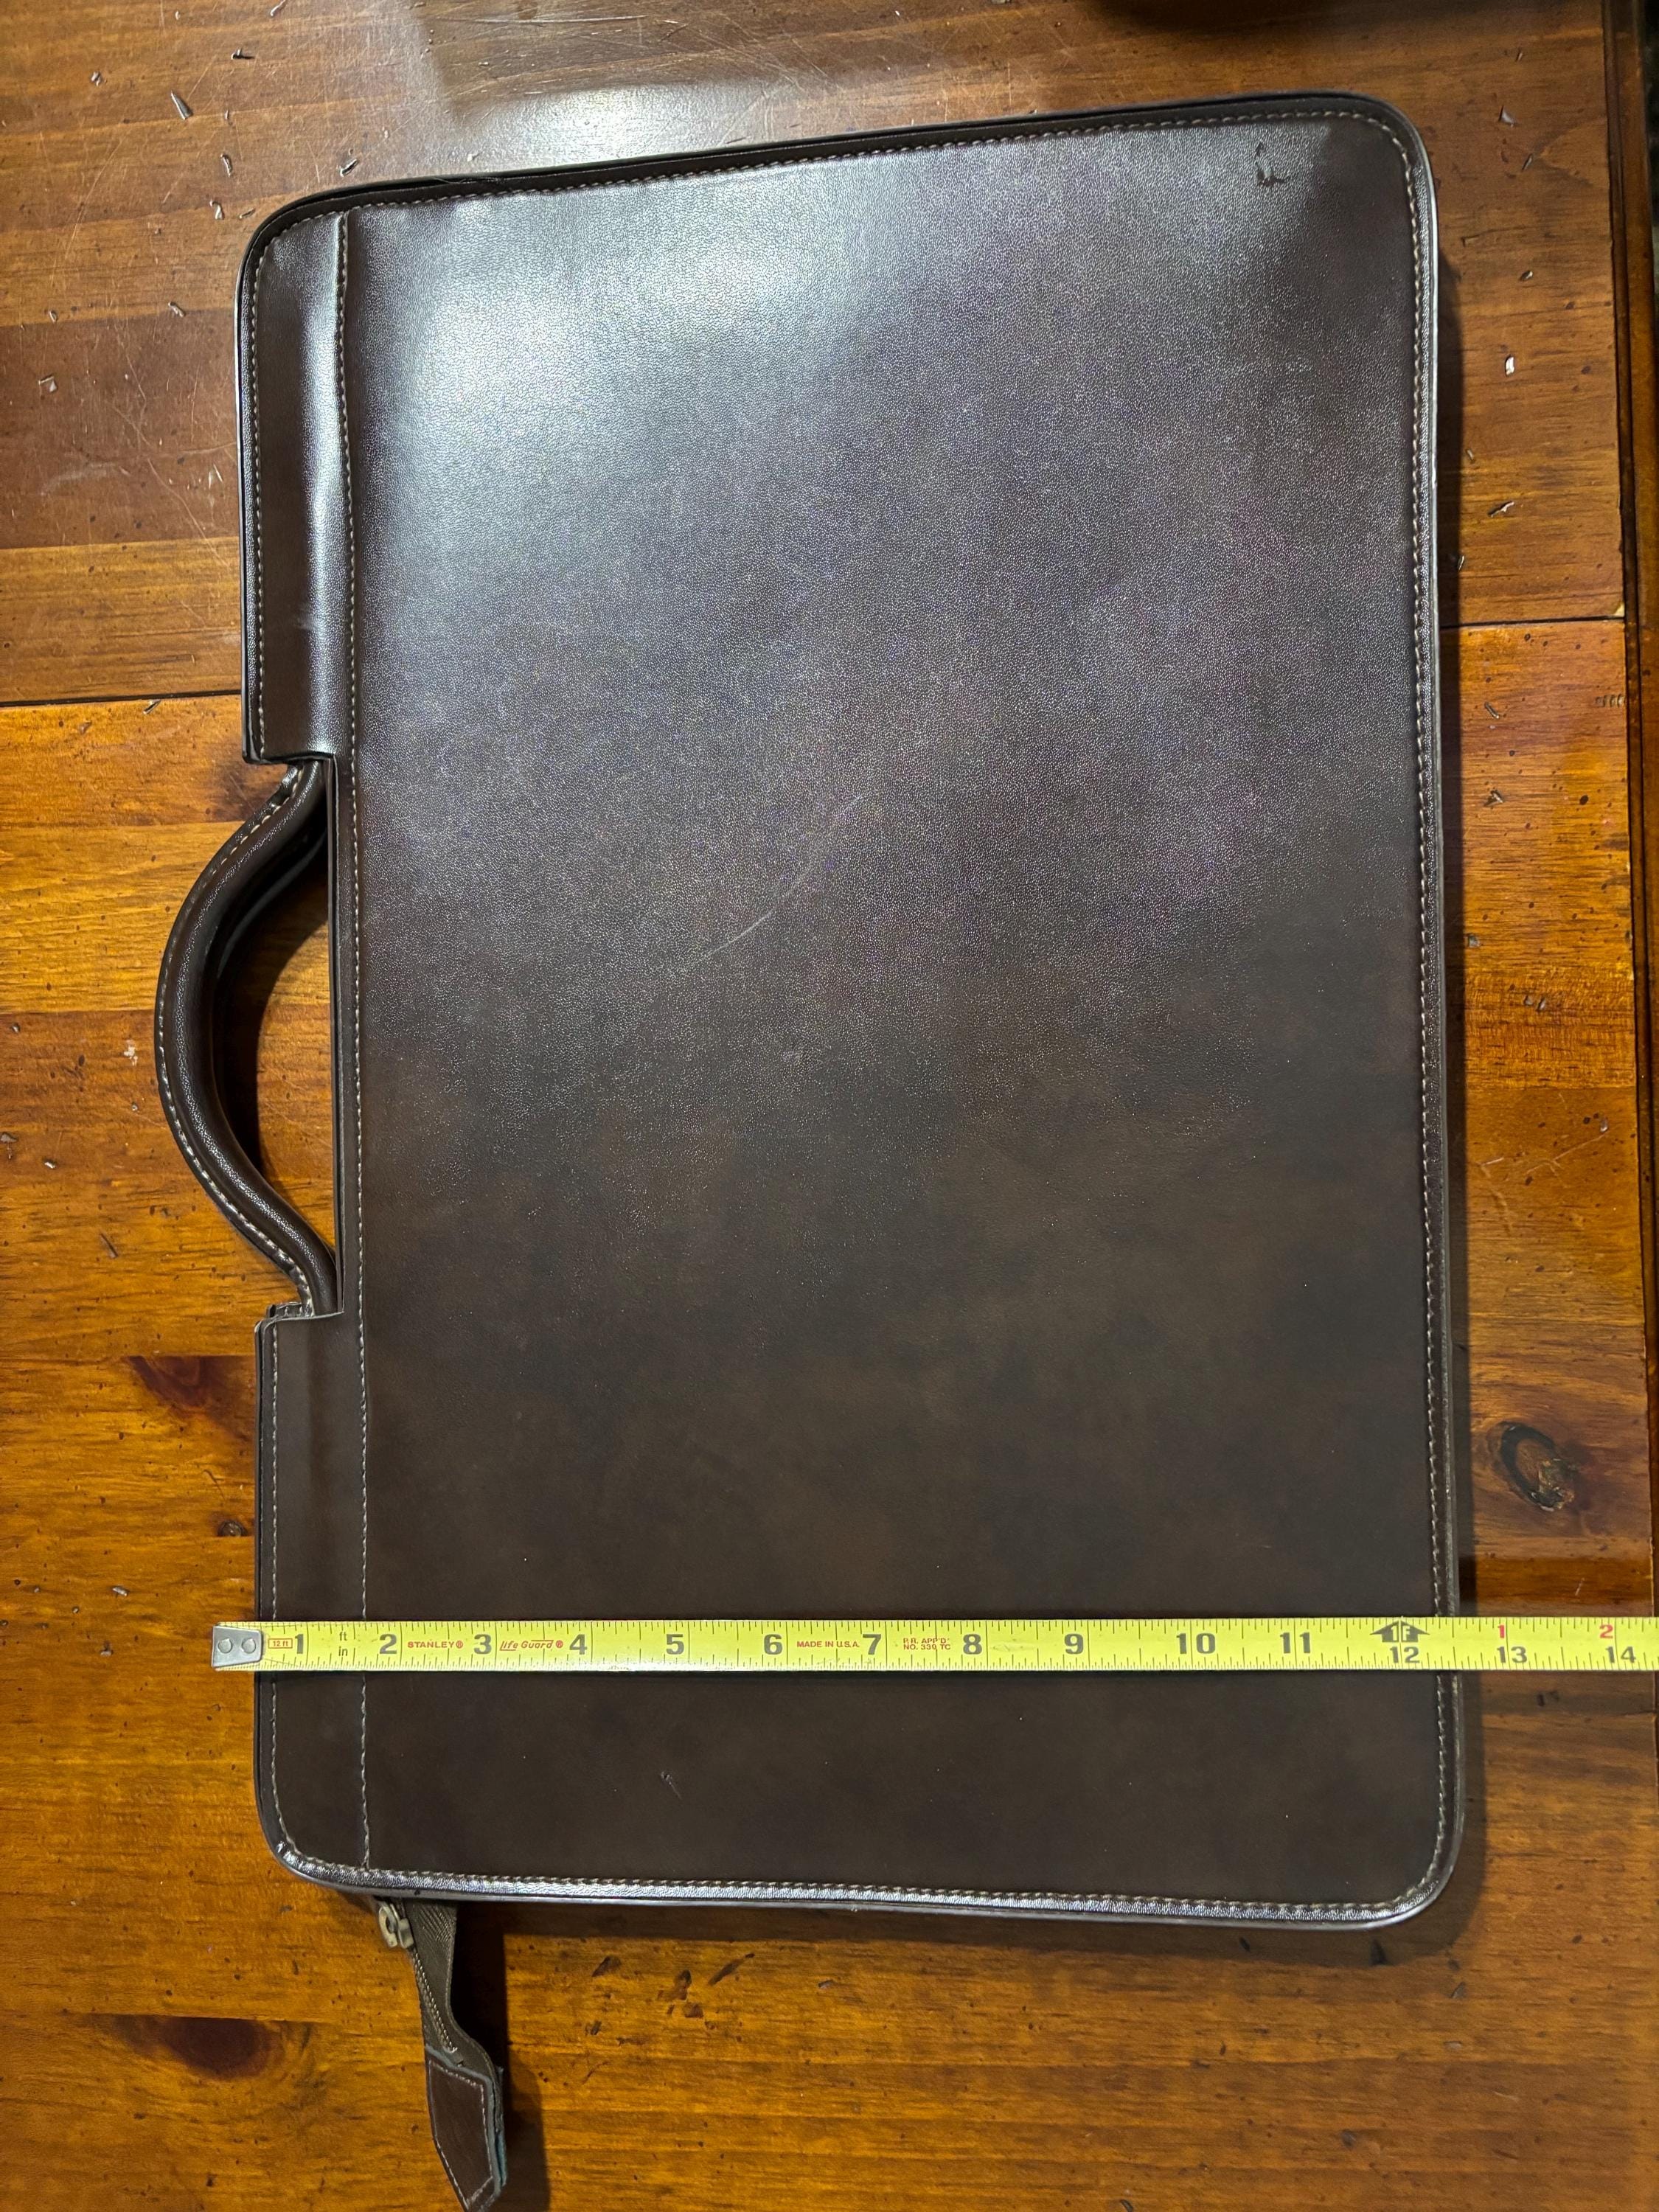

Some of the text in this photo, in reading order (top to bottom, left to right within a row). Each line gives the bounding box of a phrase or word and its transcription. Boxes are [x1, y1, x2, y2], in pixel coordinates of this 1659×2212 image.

[339, 1631, 347, 1641] ft
[1498, 1624, 1505, 1638] 1
[1599, 1624, 1613, 1638] 2
[295, 1633, 304, 1655] 1
[338, 1646, 348, 1657] in
[379, 1633, 397, 1655] 2
[473, 1633, 492, 1655] 3
[569, 1633, 588, 1655] 4
[666, 1633, 685, 1655] 5
[763, 1633, 783, 1655] 6
[863, 1633, 882, 1655] 7
[962, 1633, 983, 1655] 8
[1064, 1633, 1084, 1655] 9
[1176, 1632, 1216, 1655] 10
[1279, 1632, 1311, 1654] 11
[1390, 1646, 1420, 1663] 12
[1497, 1646, 1527, 1663] 13
[1605, 1646, 1636, 1663] 14
